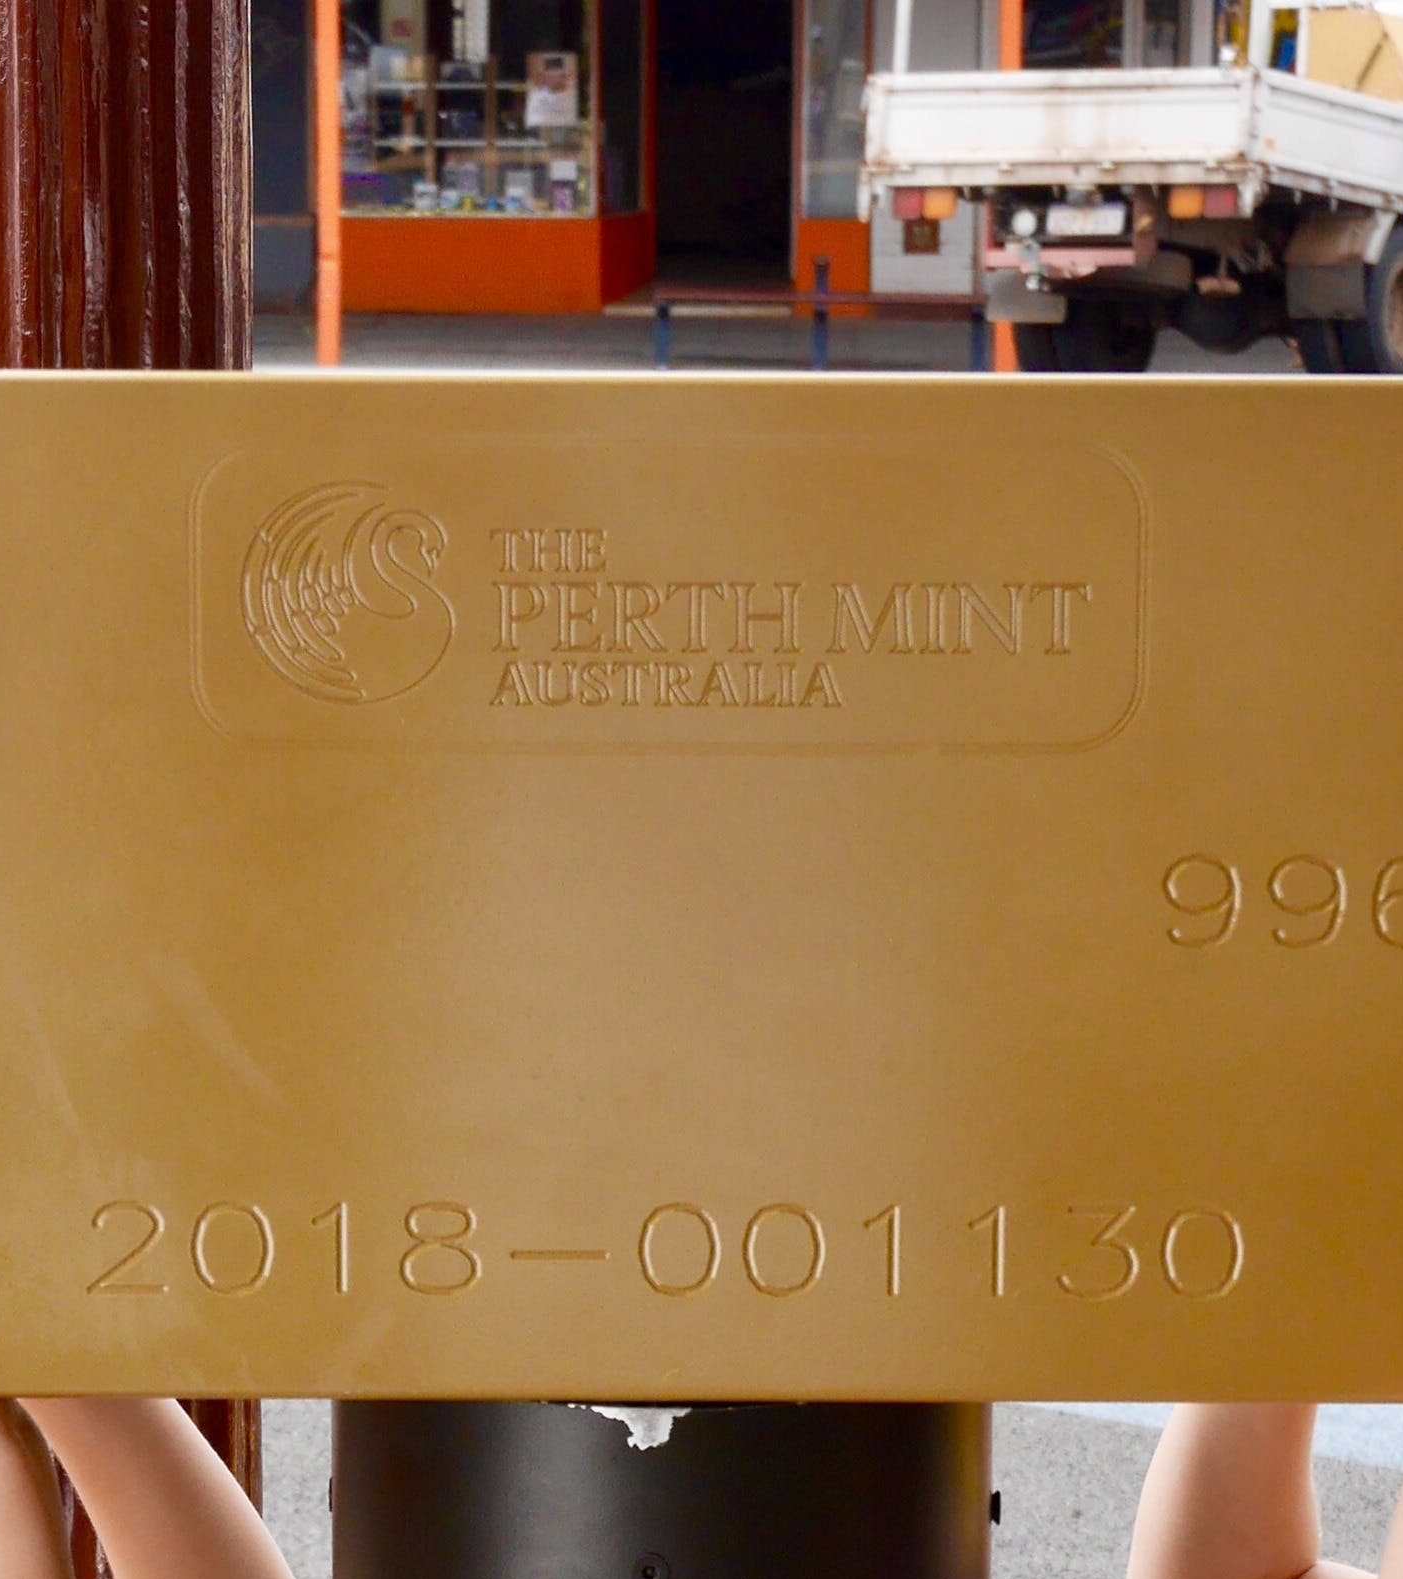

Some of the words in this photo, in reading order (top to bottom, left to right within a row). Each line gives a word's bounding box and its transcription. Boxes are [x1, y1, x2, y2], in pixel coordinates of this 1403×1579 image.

[489, 528, 608, 573] THE
[490, 581, 804, 654] PERTH
[826, 582, 1094, 655] MINT
[489, 660, 843, 707] AUSTRALIA
